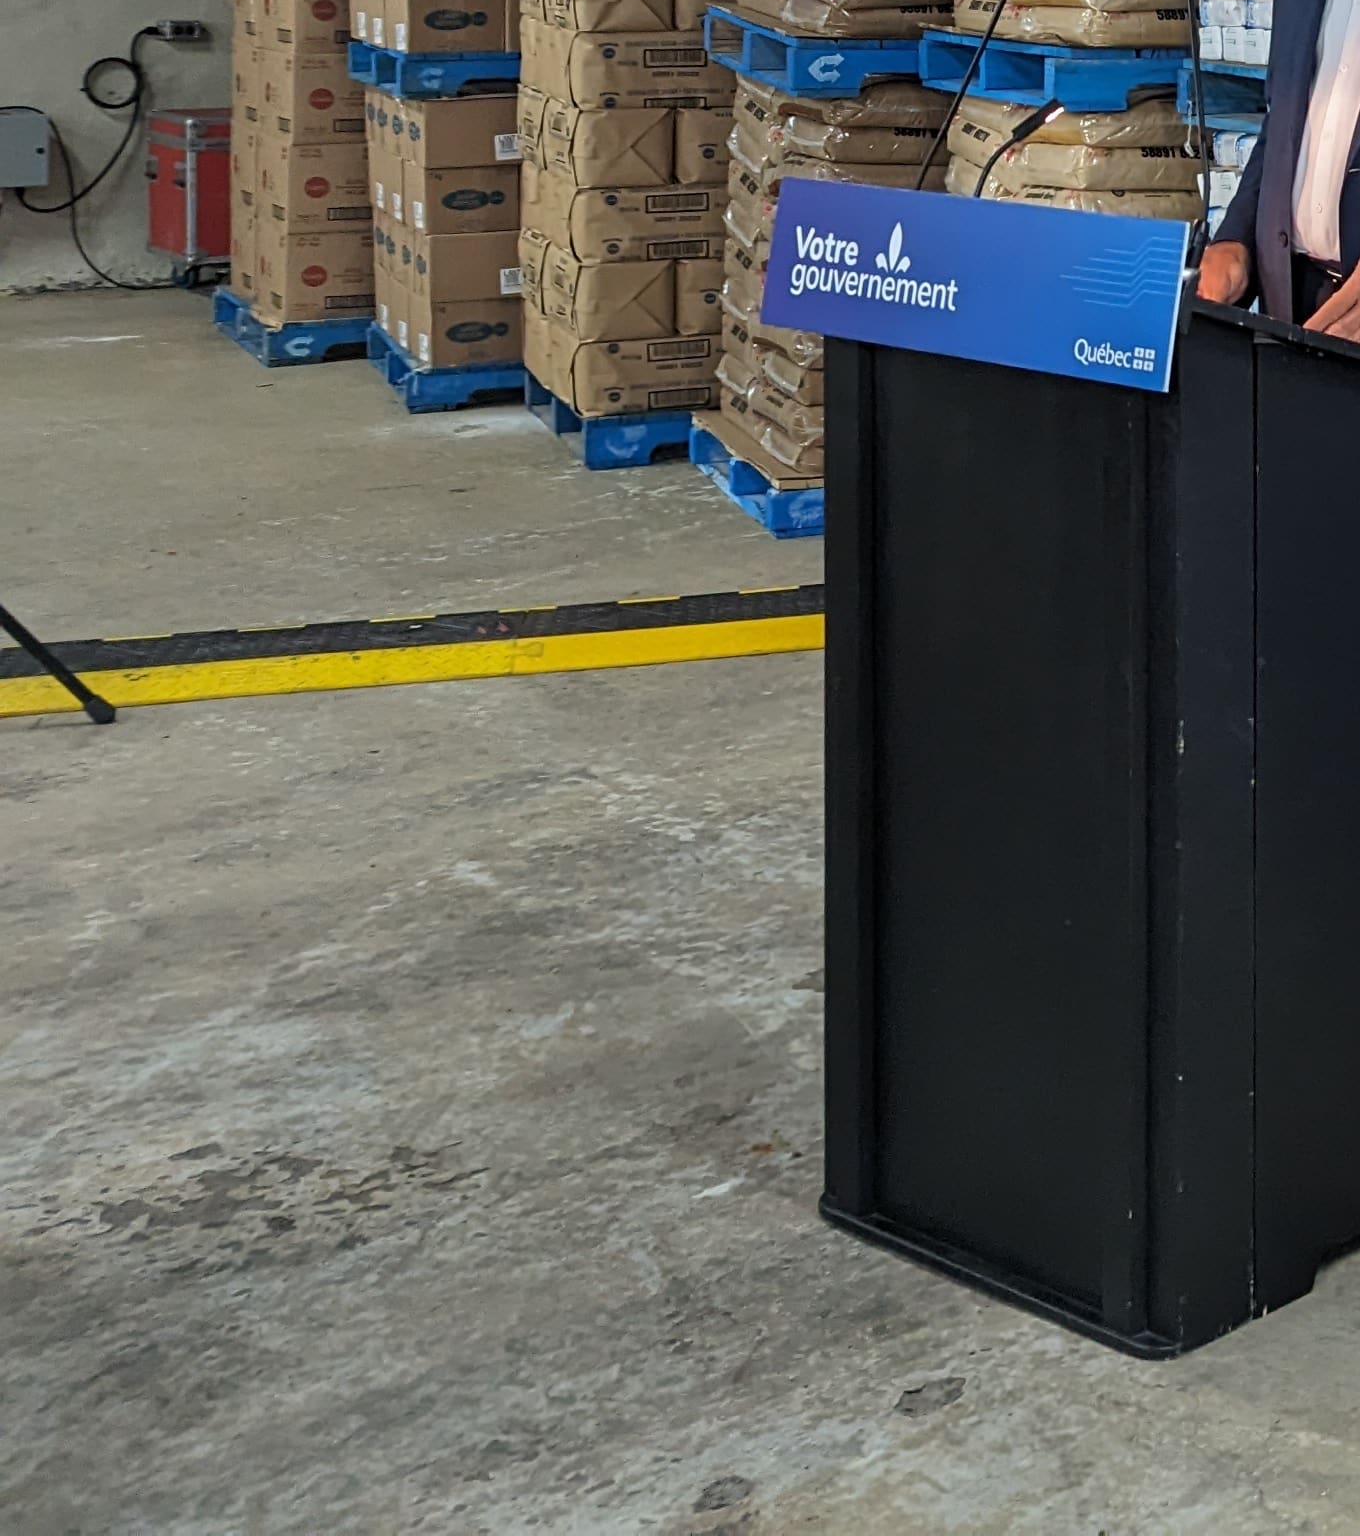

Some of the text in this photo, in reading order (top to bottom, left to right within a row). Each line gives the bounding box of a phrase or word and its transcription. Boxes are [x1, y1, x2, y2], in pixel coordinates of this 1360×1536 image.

[795, 225, 858, 265] Votre
[789, 261, 958, 311] gouvernement
[1074, 338, 1131, 369] Québec
